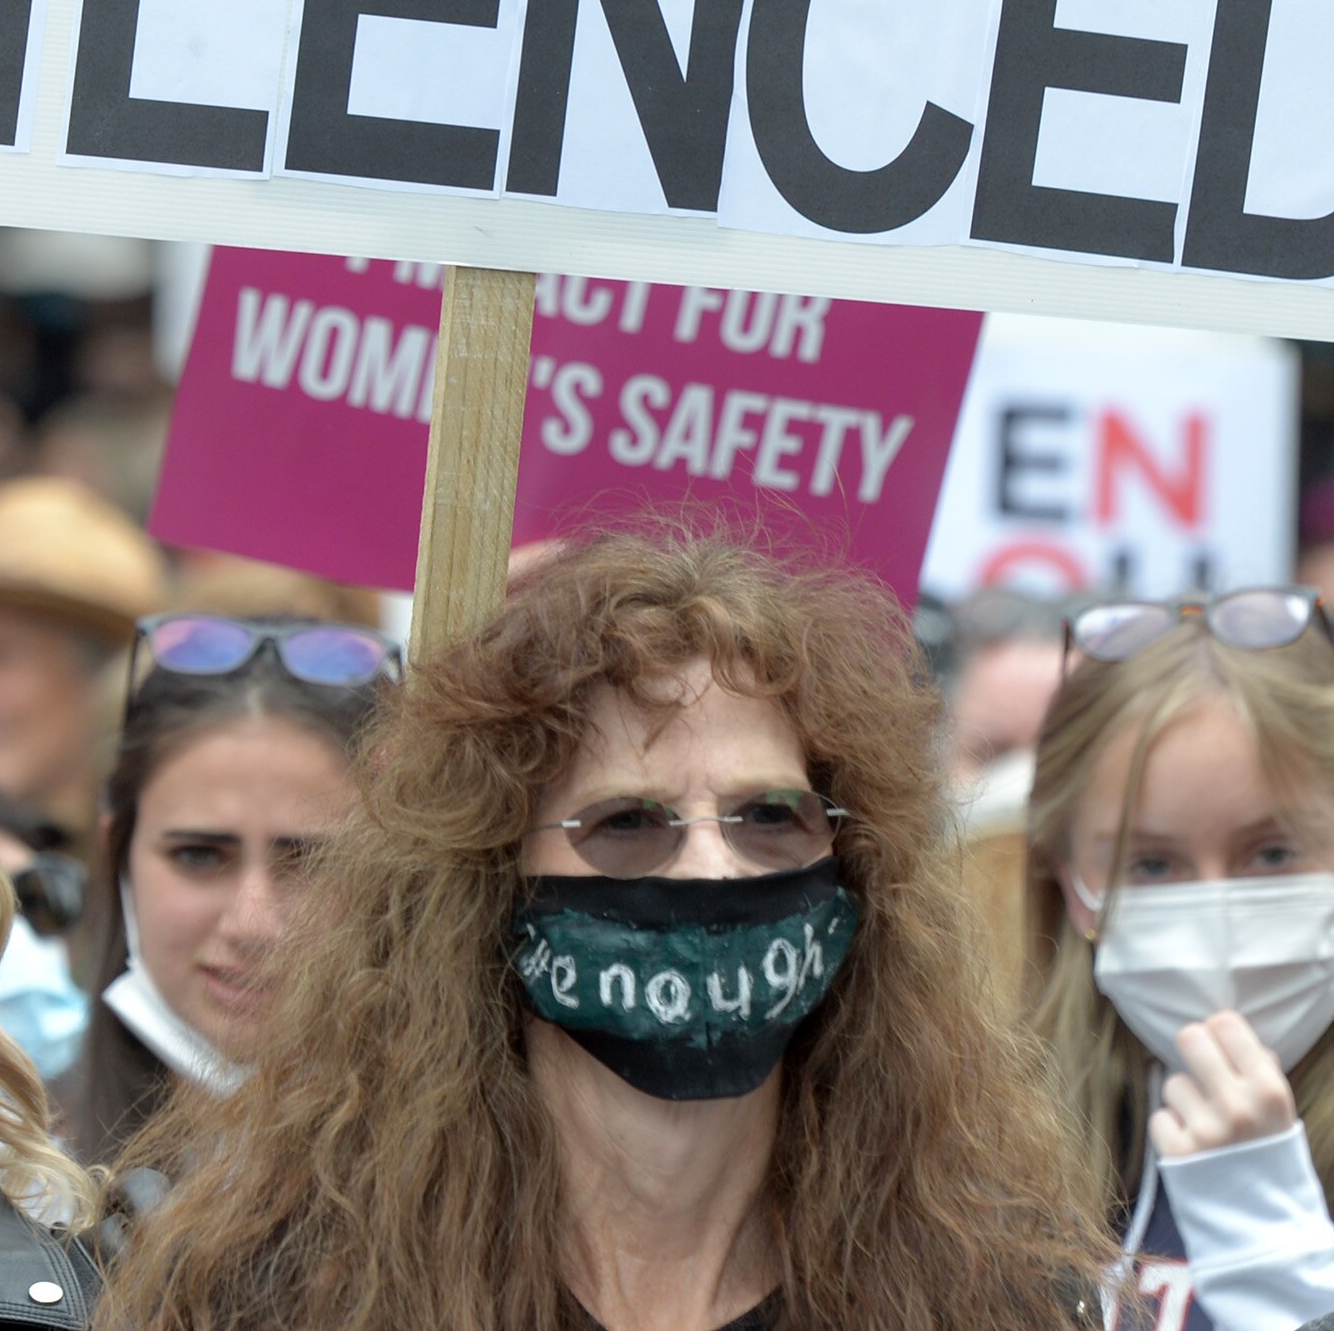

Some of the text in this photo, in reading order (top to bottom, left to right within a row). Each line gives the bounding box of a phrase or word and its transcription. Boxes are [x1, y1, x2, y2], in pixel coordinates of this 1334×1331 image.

[231, 285, 915, 503] WOM'S SAFETY
[995, 401, 1210, 527] EN
